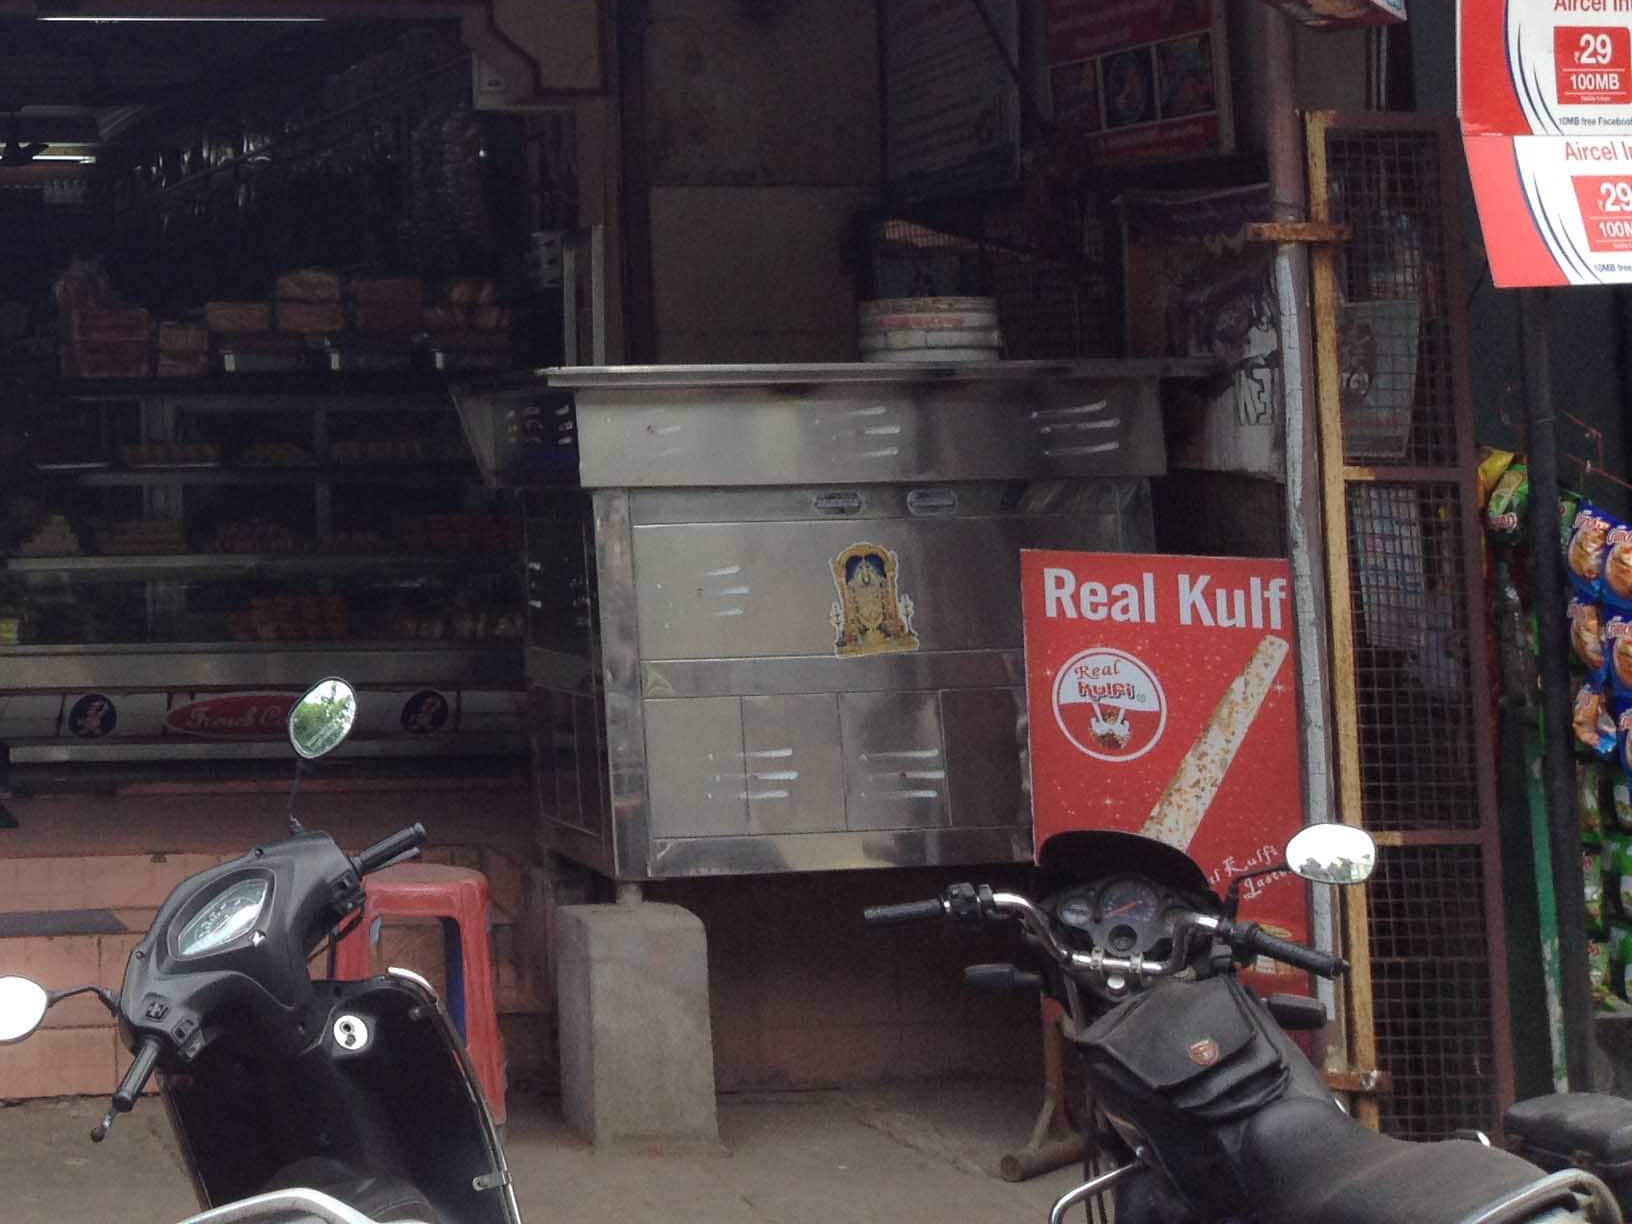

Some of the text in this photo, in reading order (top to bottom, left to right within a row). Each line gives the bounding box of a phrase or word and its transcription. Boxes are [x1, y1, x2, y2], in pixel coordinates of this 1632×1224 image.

[1570, 73, 1620, 90] 100MB
[1565, 140, 1618, 160] Aircel
[1043, 567, 1288, 630] Real Kulf
